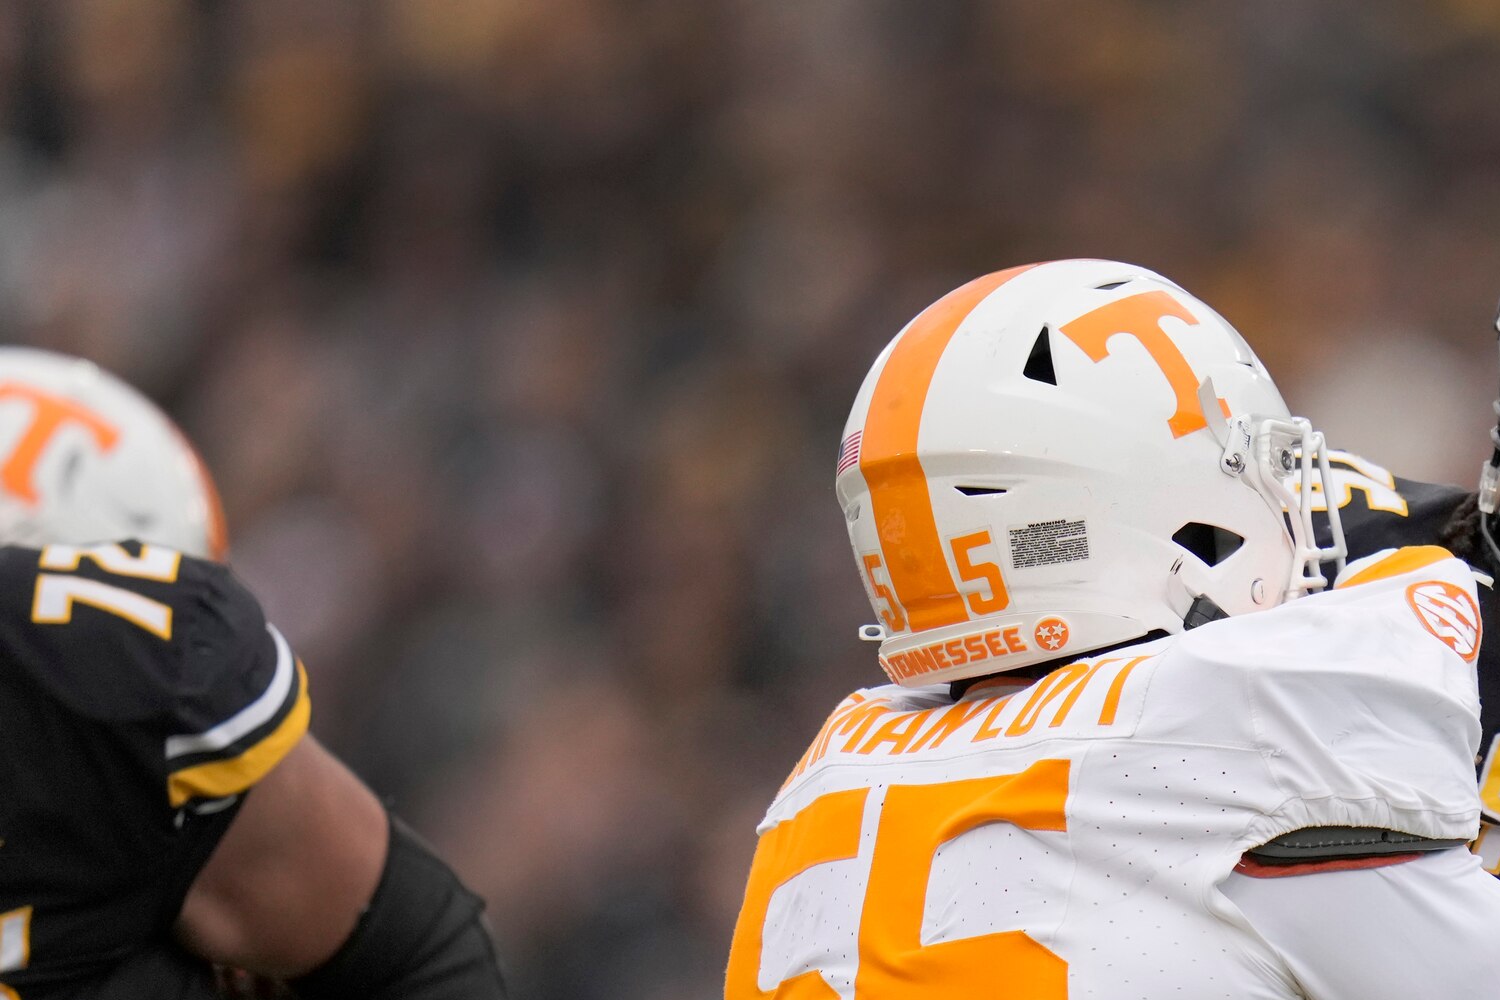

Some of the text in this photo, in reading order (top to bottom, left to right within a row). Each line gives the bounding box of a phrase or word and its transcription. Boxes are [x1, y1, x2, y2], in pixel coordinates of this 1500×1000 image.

[1060, 290, 1231, 439] T
[1027, 519, 1066, 528] WARNING
[950, 530, 1010, 615] 5
[887, 627, 1028, 680] TENNESSEE
